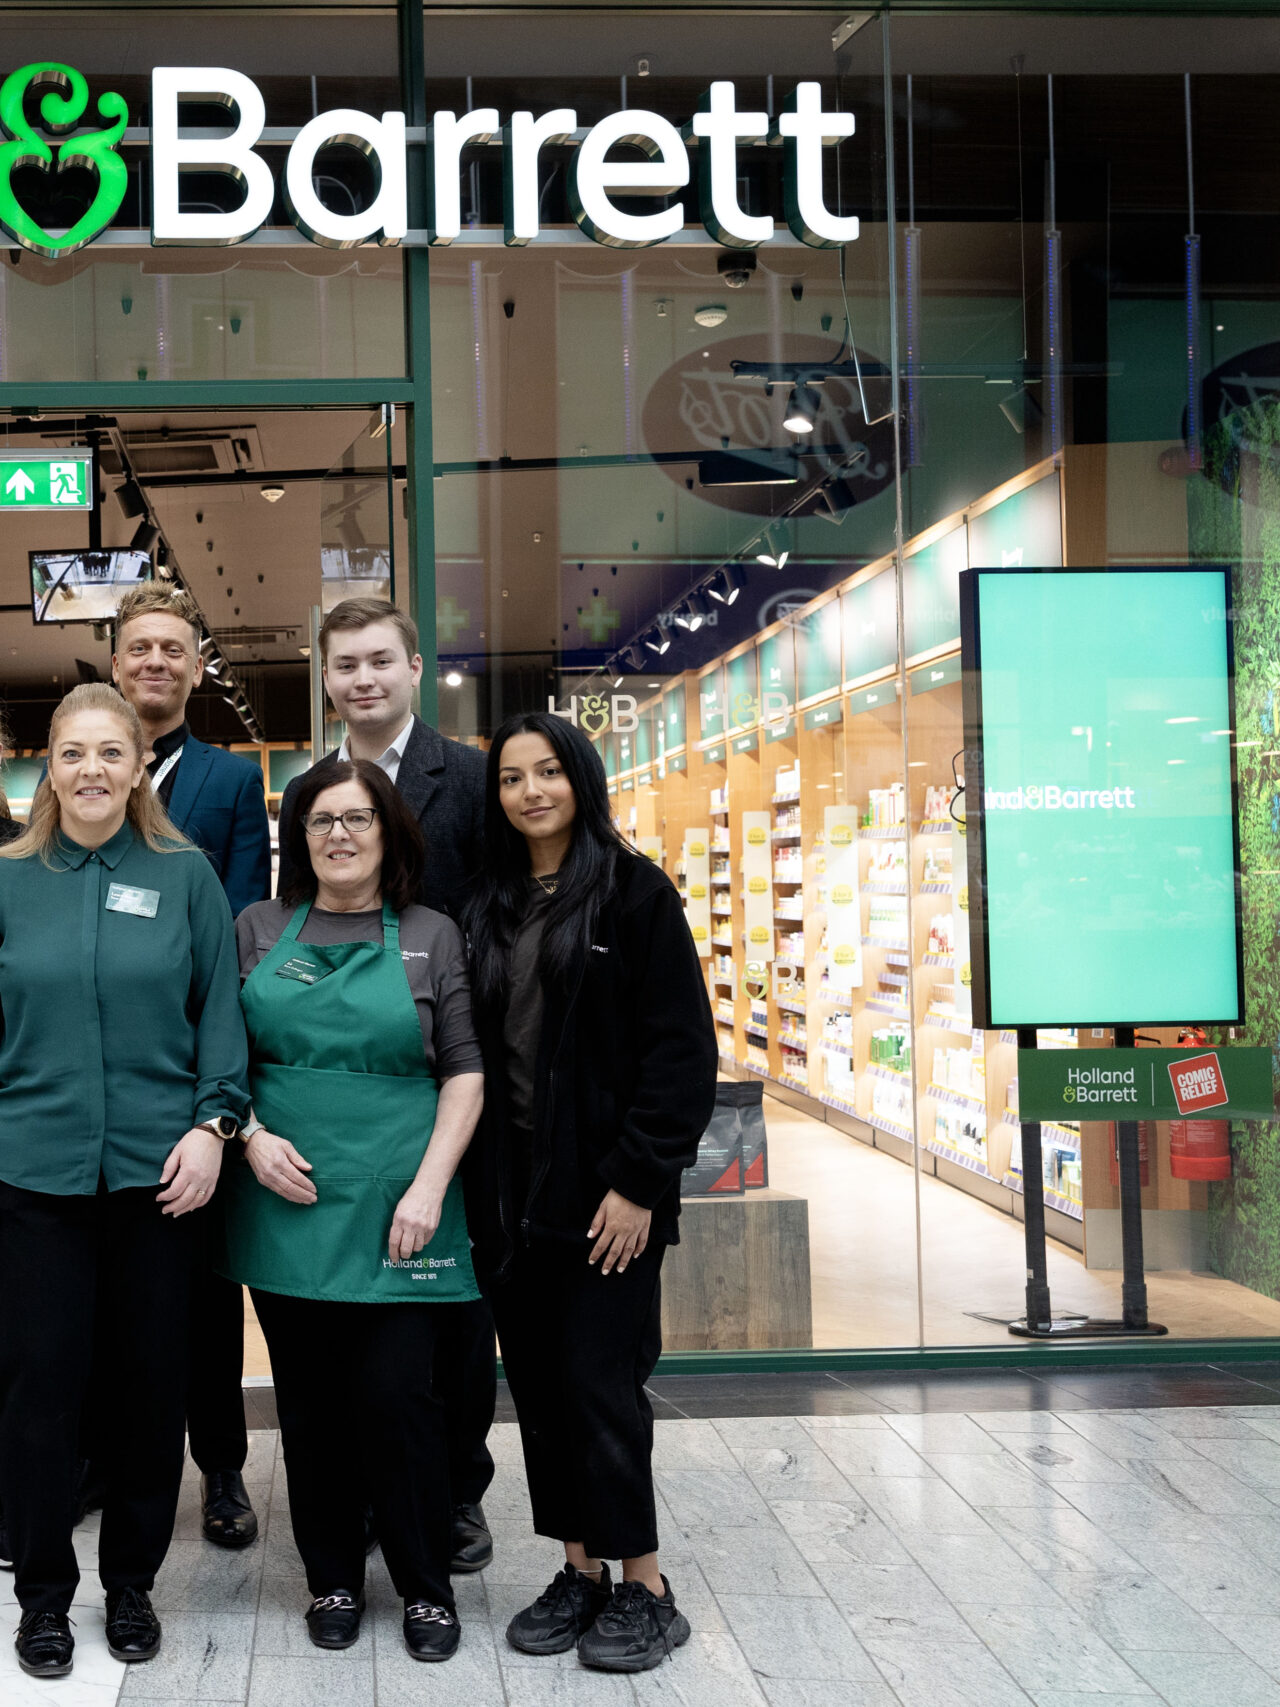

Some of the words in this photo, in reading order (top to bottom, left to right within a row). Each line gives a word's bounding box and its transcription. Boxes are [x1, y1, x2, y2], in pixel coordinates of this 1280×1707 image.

[699, 691, 790, 730] H&B
[708, 962, 800, 1001] H&B
[1067, 1067, 1135, 1084] Holland
[1176, 1066, 1216, 1087] COMIC
[1062, 1085, 1138, 1104] &Barrett
[1180, 1079, 1218, 1102] RELIEF
